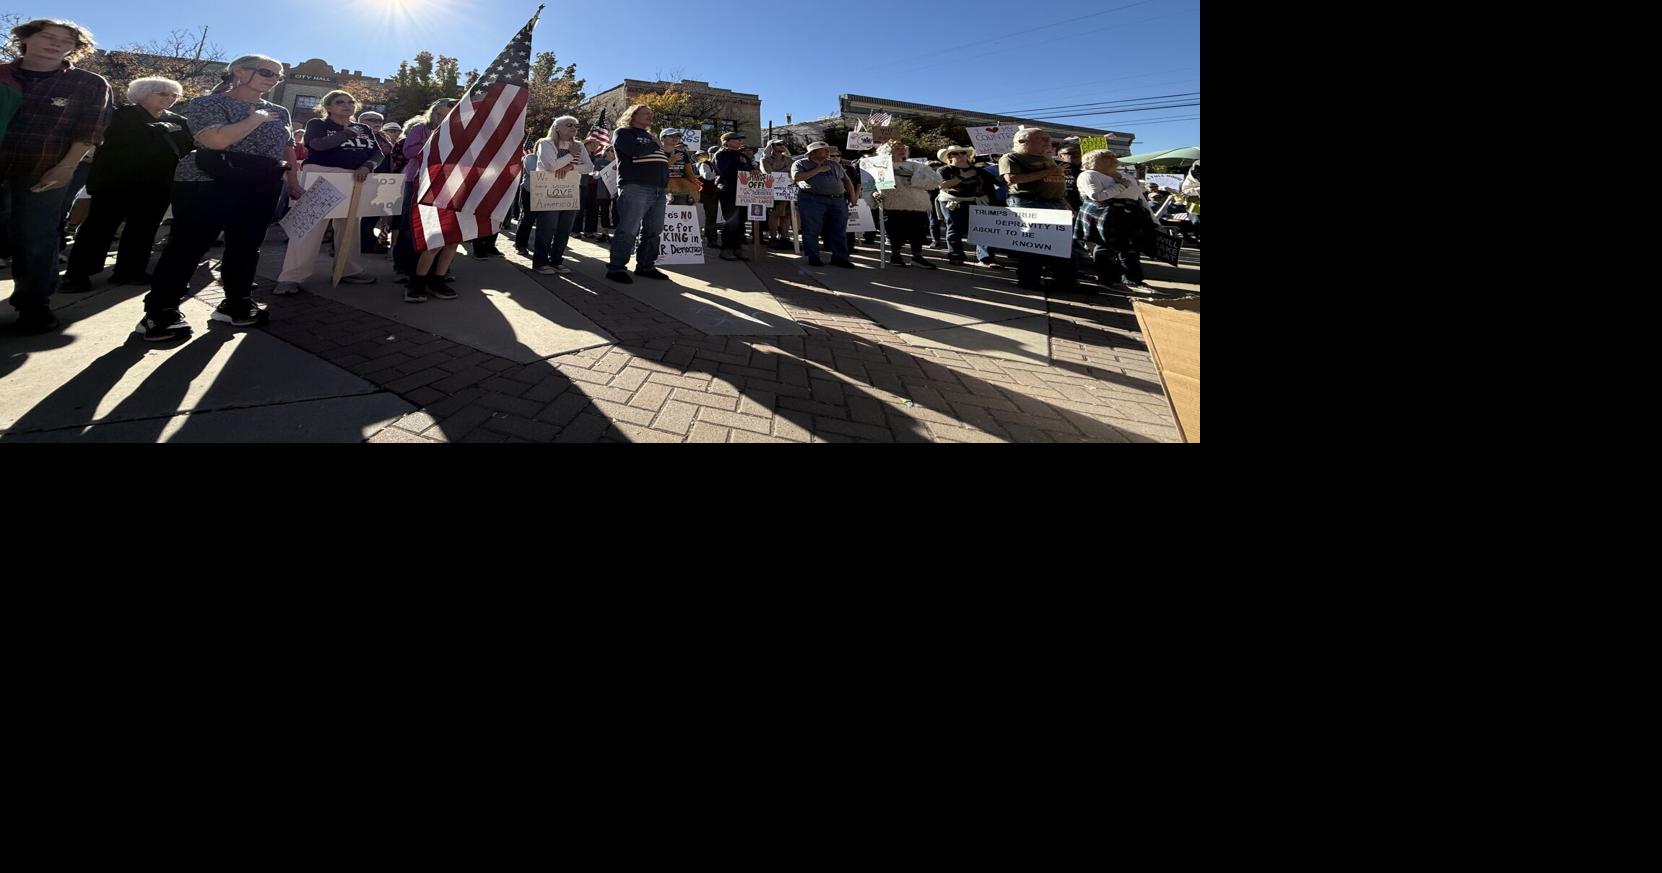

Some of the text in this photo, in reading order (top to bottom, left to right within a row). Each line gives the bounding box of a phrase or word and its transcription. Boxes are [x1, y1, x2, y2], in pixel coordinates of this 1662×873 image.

[976, 133, 1013, 141] COUNTR
[547, 189, 573, 198] LOVE
[681, 211, 692, 219] NO
[975, 209, 1008, 217] TRUMPS
[677, 223, 693, 232] for
[995, 219, 1051, 231] DEPRAVITY
[973, 226, 1001, 234] ABOUT
[1022, 231, 1035, 239] BE
[663, 233, 689, 243] KING
[1012, 240, 1052, 251] KNOWN
